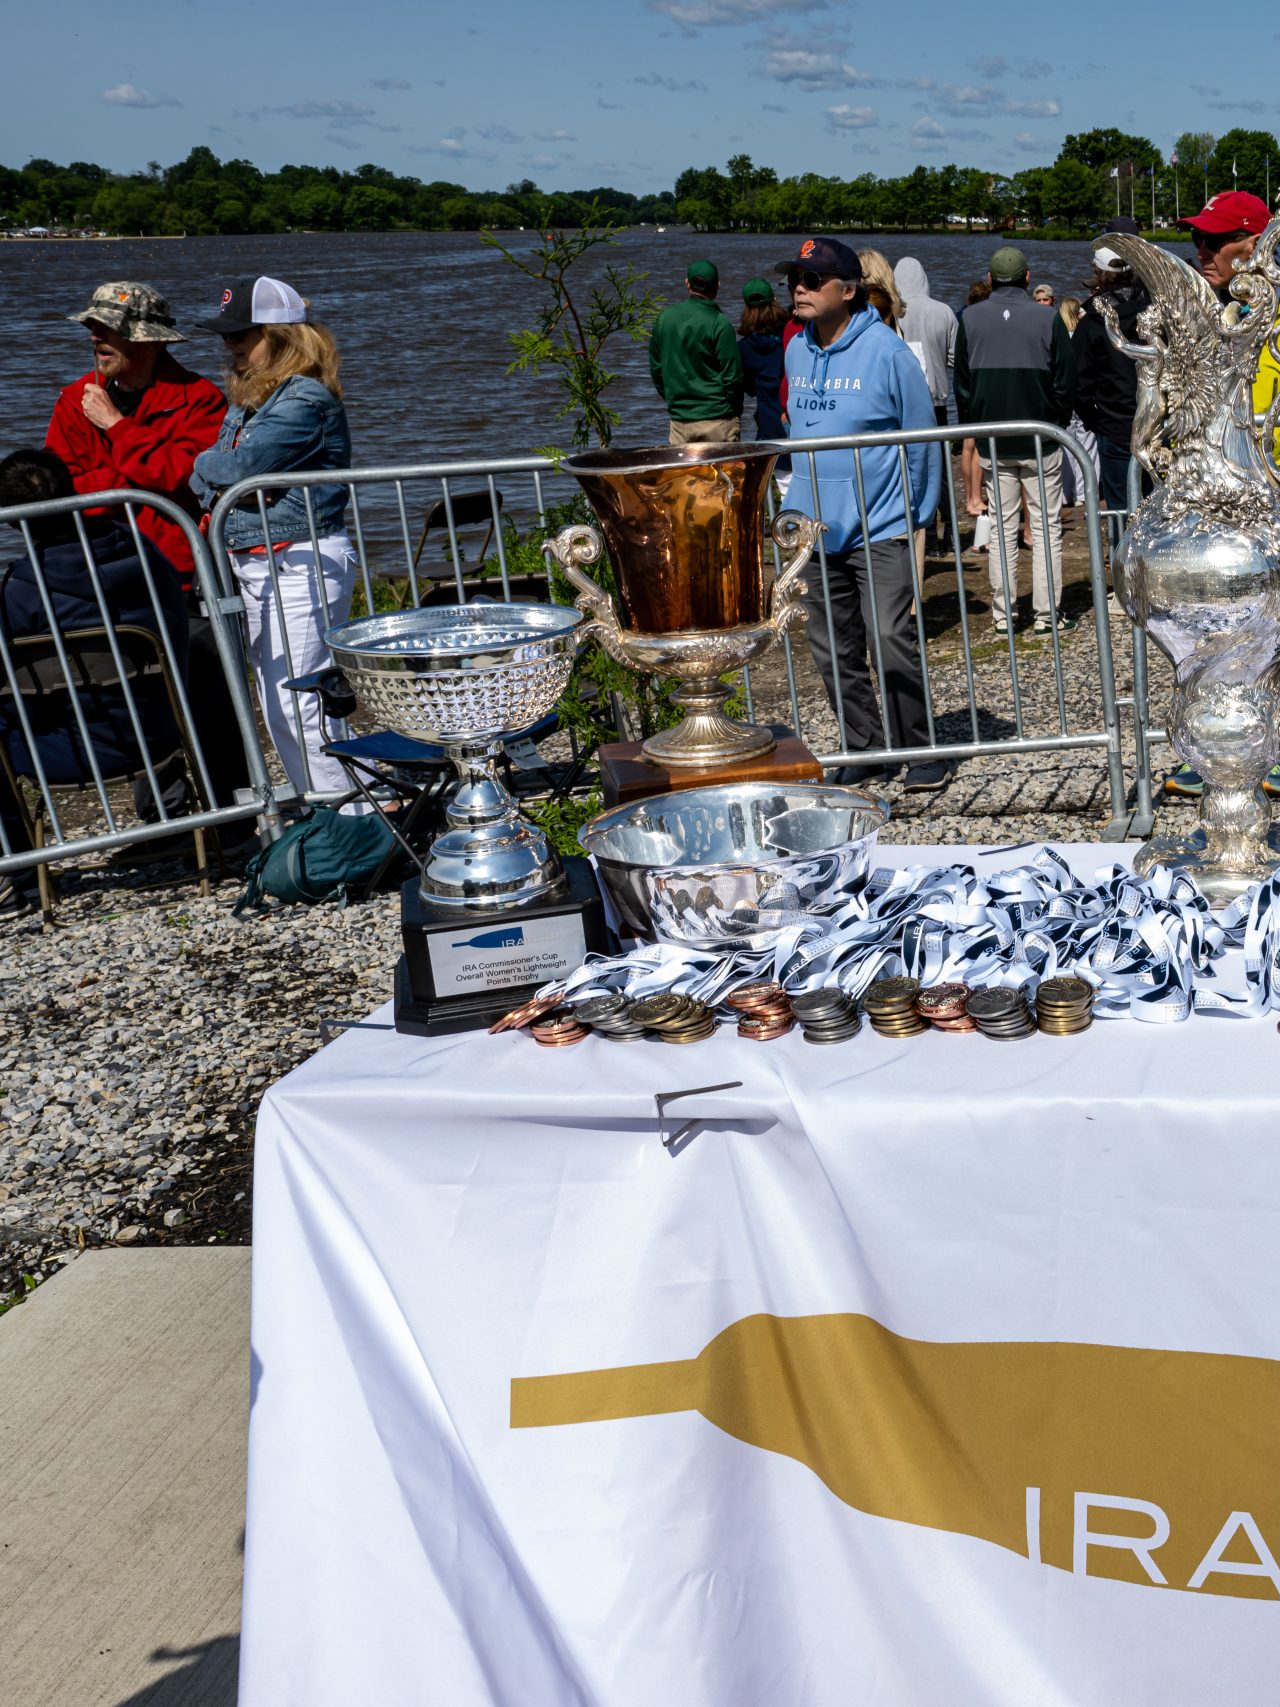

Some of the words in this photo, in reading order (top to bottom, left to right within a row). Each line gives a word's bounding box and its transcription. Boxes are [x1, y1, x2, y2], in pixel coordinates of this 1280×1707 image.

[220, 288, 233, 312] P
[796, 398, 837, 411] LIONS
[501, 938, 525, 948] IRA
[455, 972, 484, 982] Overall
[486, 966, 522, 978] Women's
[523, 959, 567, 974] Lightweight
[462, 964, 478, 973] IRA
[478, 954, 541, 970] Commissioner's
[542, 953, 558, 962] Cup
[486, 976, 511, 986] Points
[513, 973, 540, 985] Trophy
[1026, 1487, 1280, 1592] IRA
